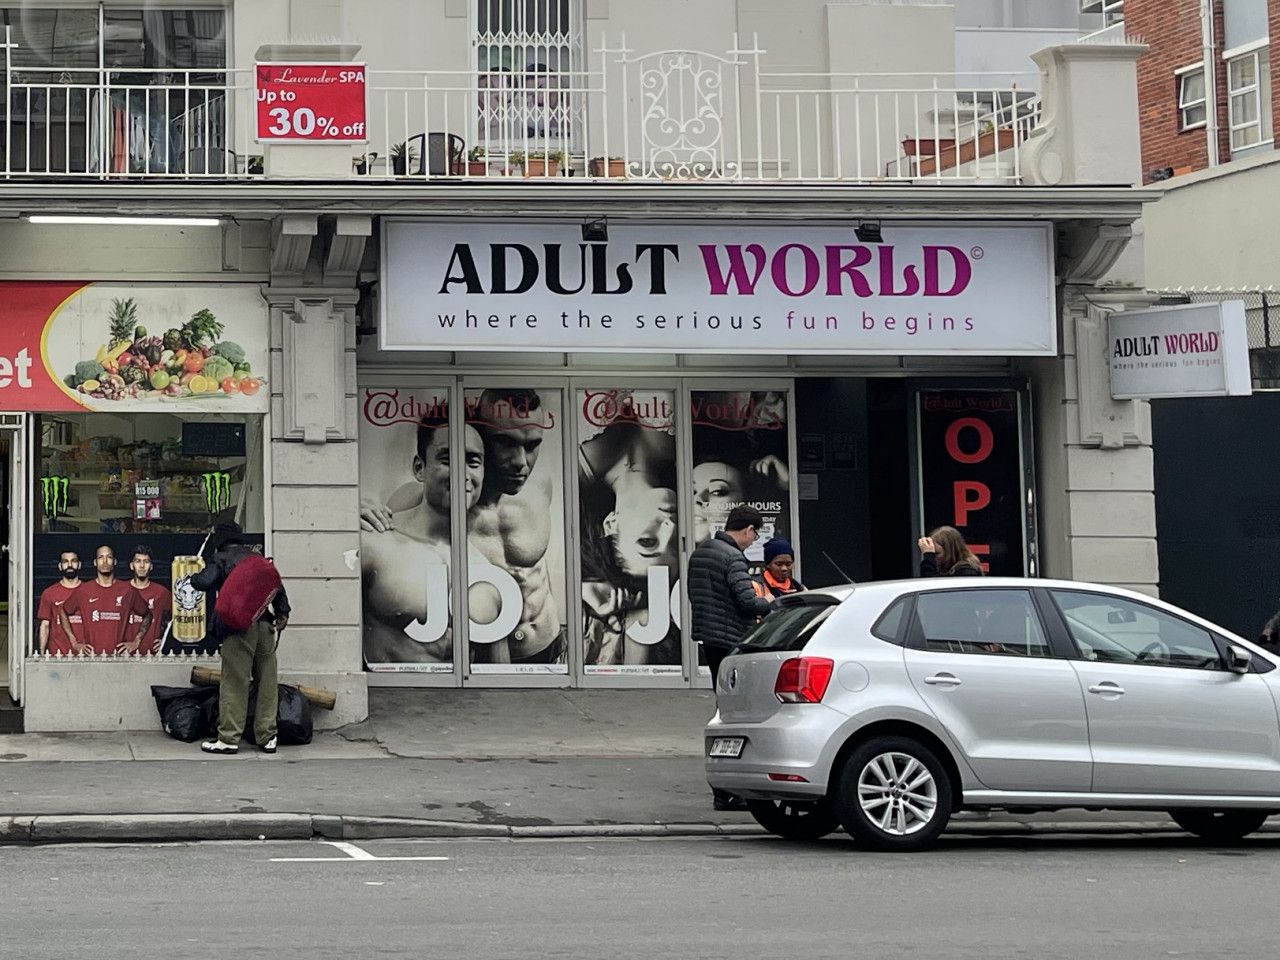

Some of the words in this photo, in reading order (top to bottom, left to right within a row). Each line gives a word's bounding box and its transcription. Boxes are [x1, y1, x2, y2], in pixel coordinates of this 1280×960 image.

[274, 68, 337, 83] Lavender
[340, 72, 365, 83] SPA
[280, 90, 296, 101] to
[269, 107, 339, 136] 30%
[343, 122, 364, 136] off
[437, 244, 680, 295] ADULT
[698, 243, 972, 297] WORLD
[438, 309, 538, 328] where
[561, 309, 613, 328] the
[636, 311, 762, 330] serious
[787, 311, 837, 330] fun
[862, 312, 974, 335] begins
[1113, 336, 1160, 358] ADULT
[1164, 331, 1219, 355] WORLD
